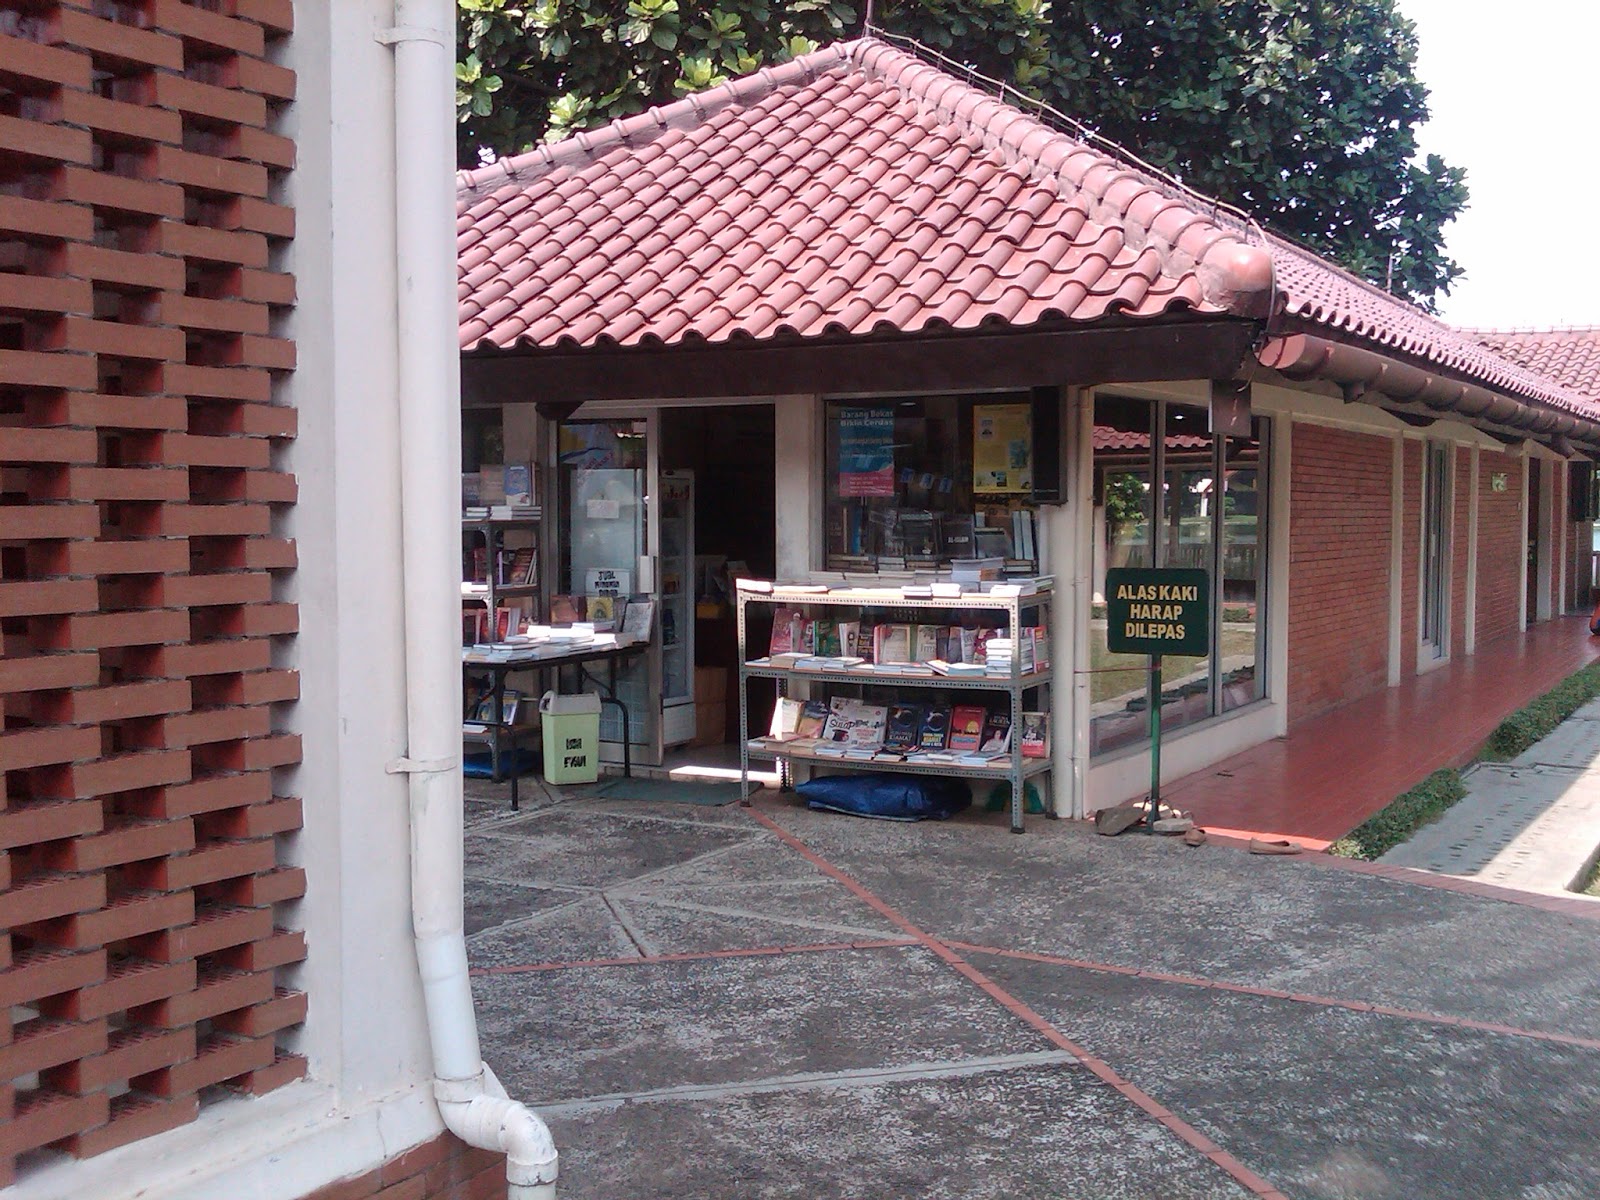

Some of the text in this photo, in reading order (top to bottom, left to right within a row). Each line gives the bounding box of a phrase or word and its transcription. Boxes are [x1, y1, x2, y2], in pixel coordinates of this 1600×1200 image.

[1117, 584, 1197, 601] ALAS KAKI
[1130, 603, 1183, 620] HARAP
[1125, 622, 1185, 640] DILEPAS
